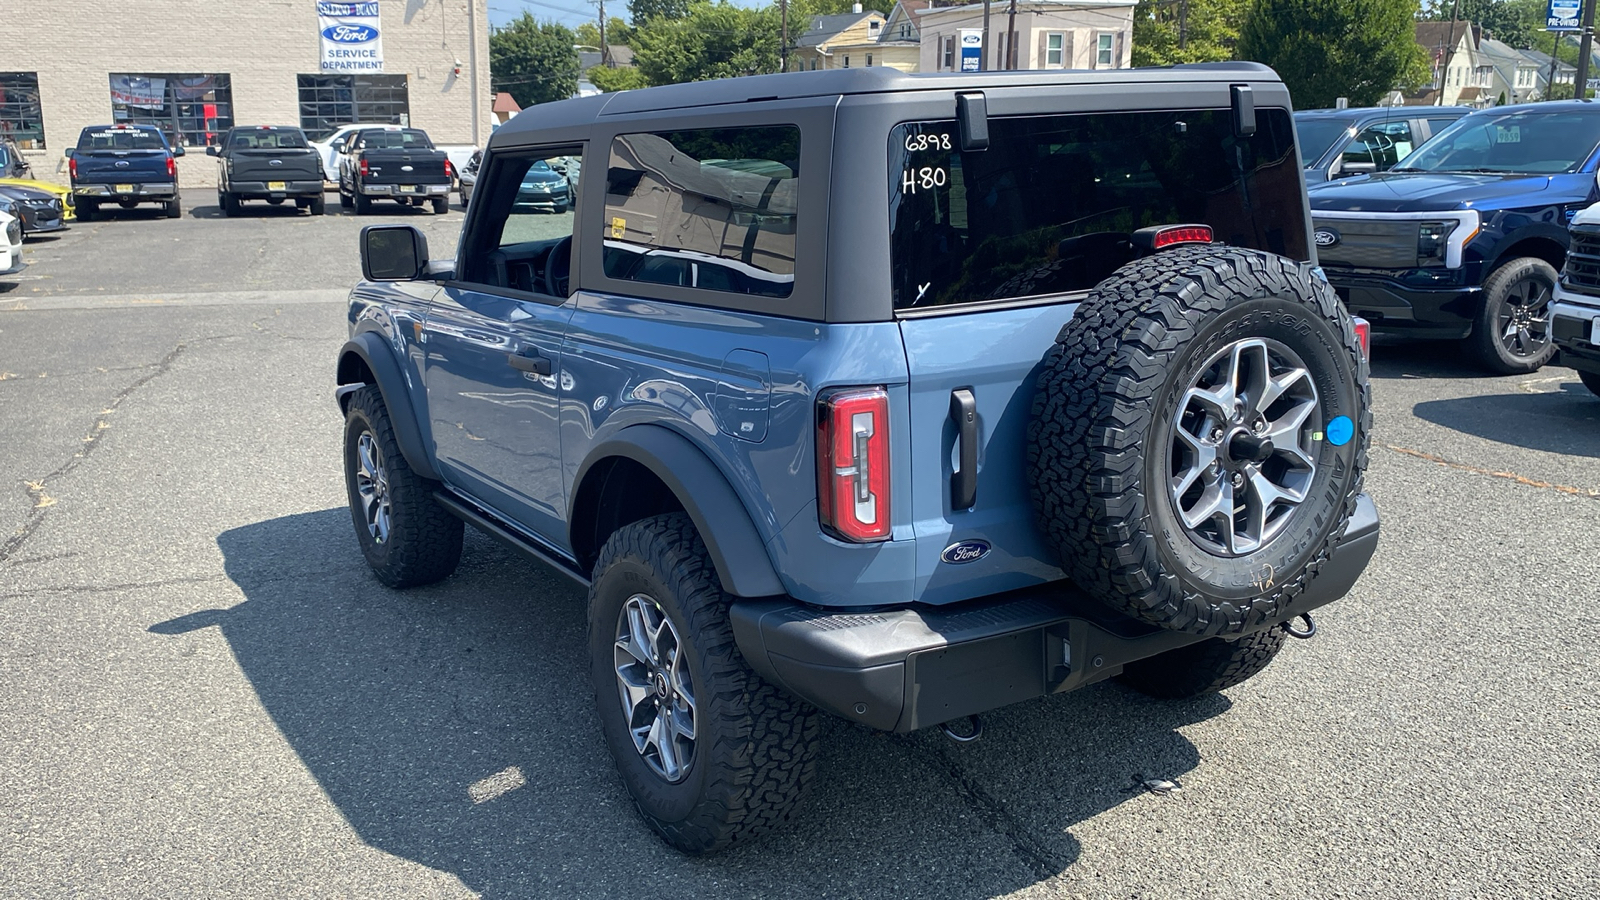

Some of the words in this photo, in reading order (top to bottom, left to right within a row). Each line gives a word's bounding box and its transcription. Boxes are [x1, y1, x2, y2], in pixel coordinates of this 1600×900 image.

[1548, 17, 1579, 27] PRE-OWNED
[333, 26, 369, 41] Ford
[328, 49, 377, 58] SERVICE
[322, 61, 383, 70] DEPARTMENT
[905, 133, 952, 151] 6898
[953, 545, 981, 561] Ford
